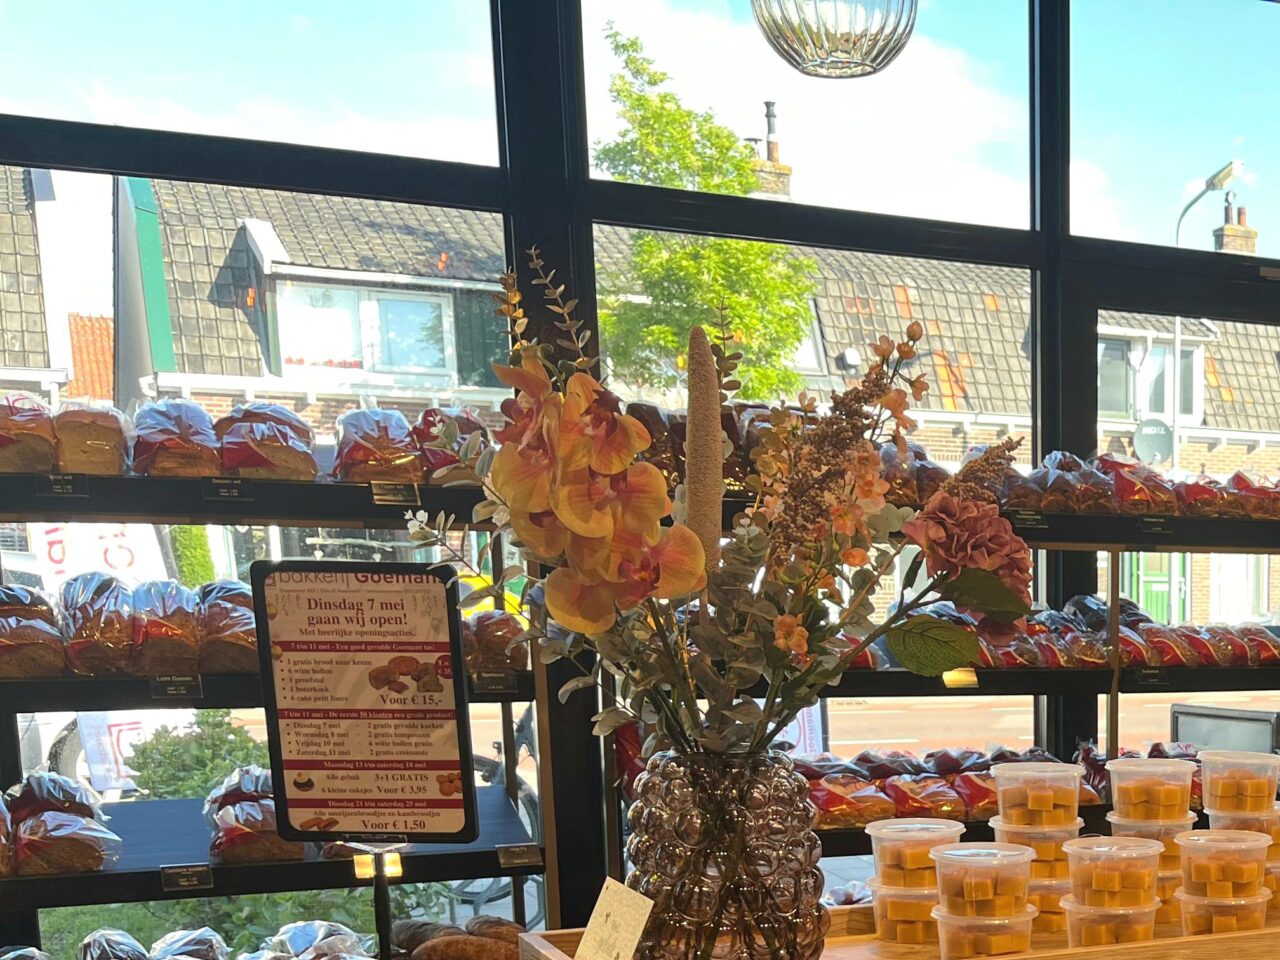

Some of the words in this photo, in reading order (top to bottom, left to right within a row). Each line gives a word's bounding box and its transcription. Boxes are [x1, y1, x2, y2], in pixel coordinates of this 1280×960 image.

[307, 598, 363, 613] Dinsdag
[367, 599, 375, 611] 7
[380, 598, 405, 611] mei
[307, 614, 340, 627] gaan
[344, 612, 366, 627] wij
[370, 613, 408, 627] open!
[299, 628, 315, 636] Met
[318, 628, 353, 637] heerlijke
[380, 694, 408, 705] Voor
[411, 695, 419, 705] €
[422, 694, 442, 706] 15,-
[374, 773, 389, 782] 3+1
[392, 773, 429, 782] GRATIS
[376, 785, 399, 794] Voor
[401, 785, 407, 794] €
[409, 785, 427, 795] 3,95
[361, 820, 391, 830] Voor
[392, 820, 400, 830] €
[404, 820, 426, 831] 1,50
